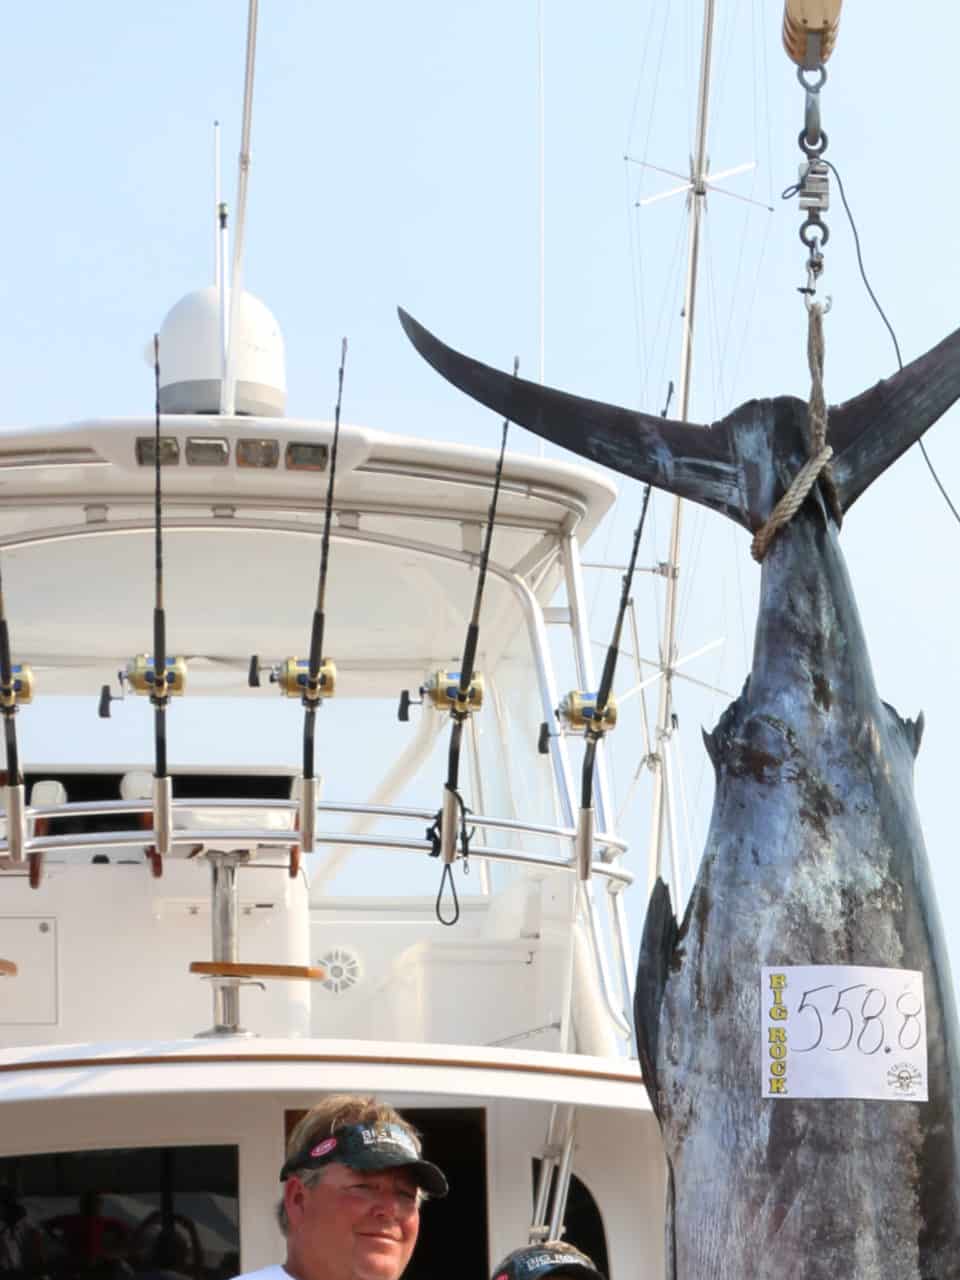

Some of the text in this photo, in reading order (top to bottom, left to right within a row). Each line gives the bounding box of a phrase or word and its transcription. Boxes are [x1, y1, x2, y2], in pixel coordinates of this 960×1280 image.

[768, 974, 788, 1094] BIG ROCK
[790, 984, 922, 1055] 558.8
